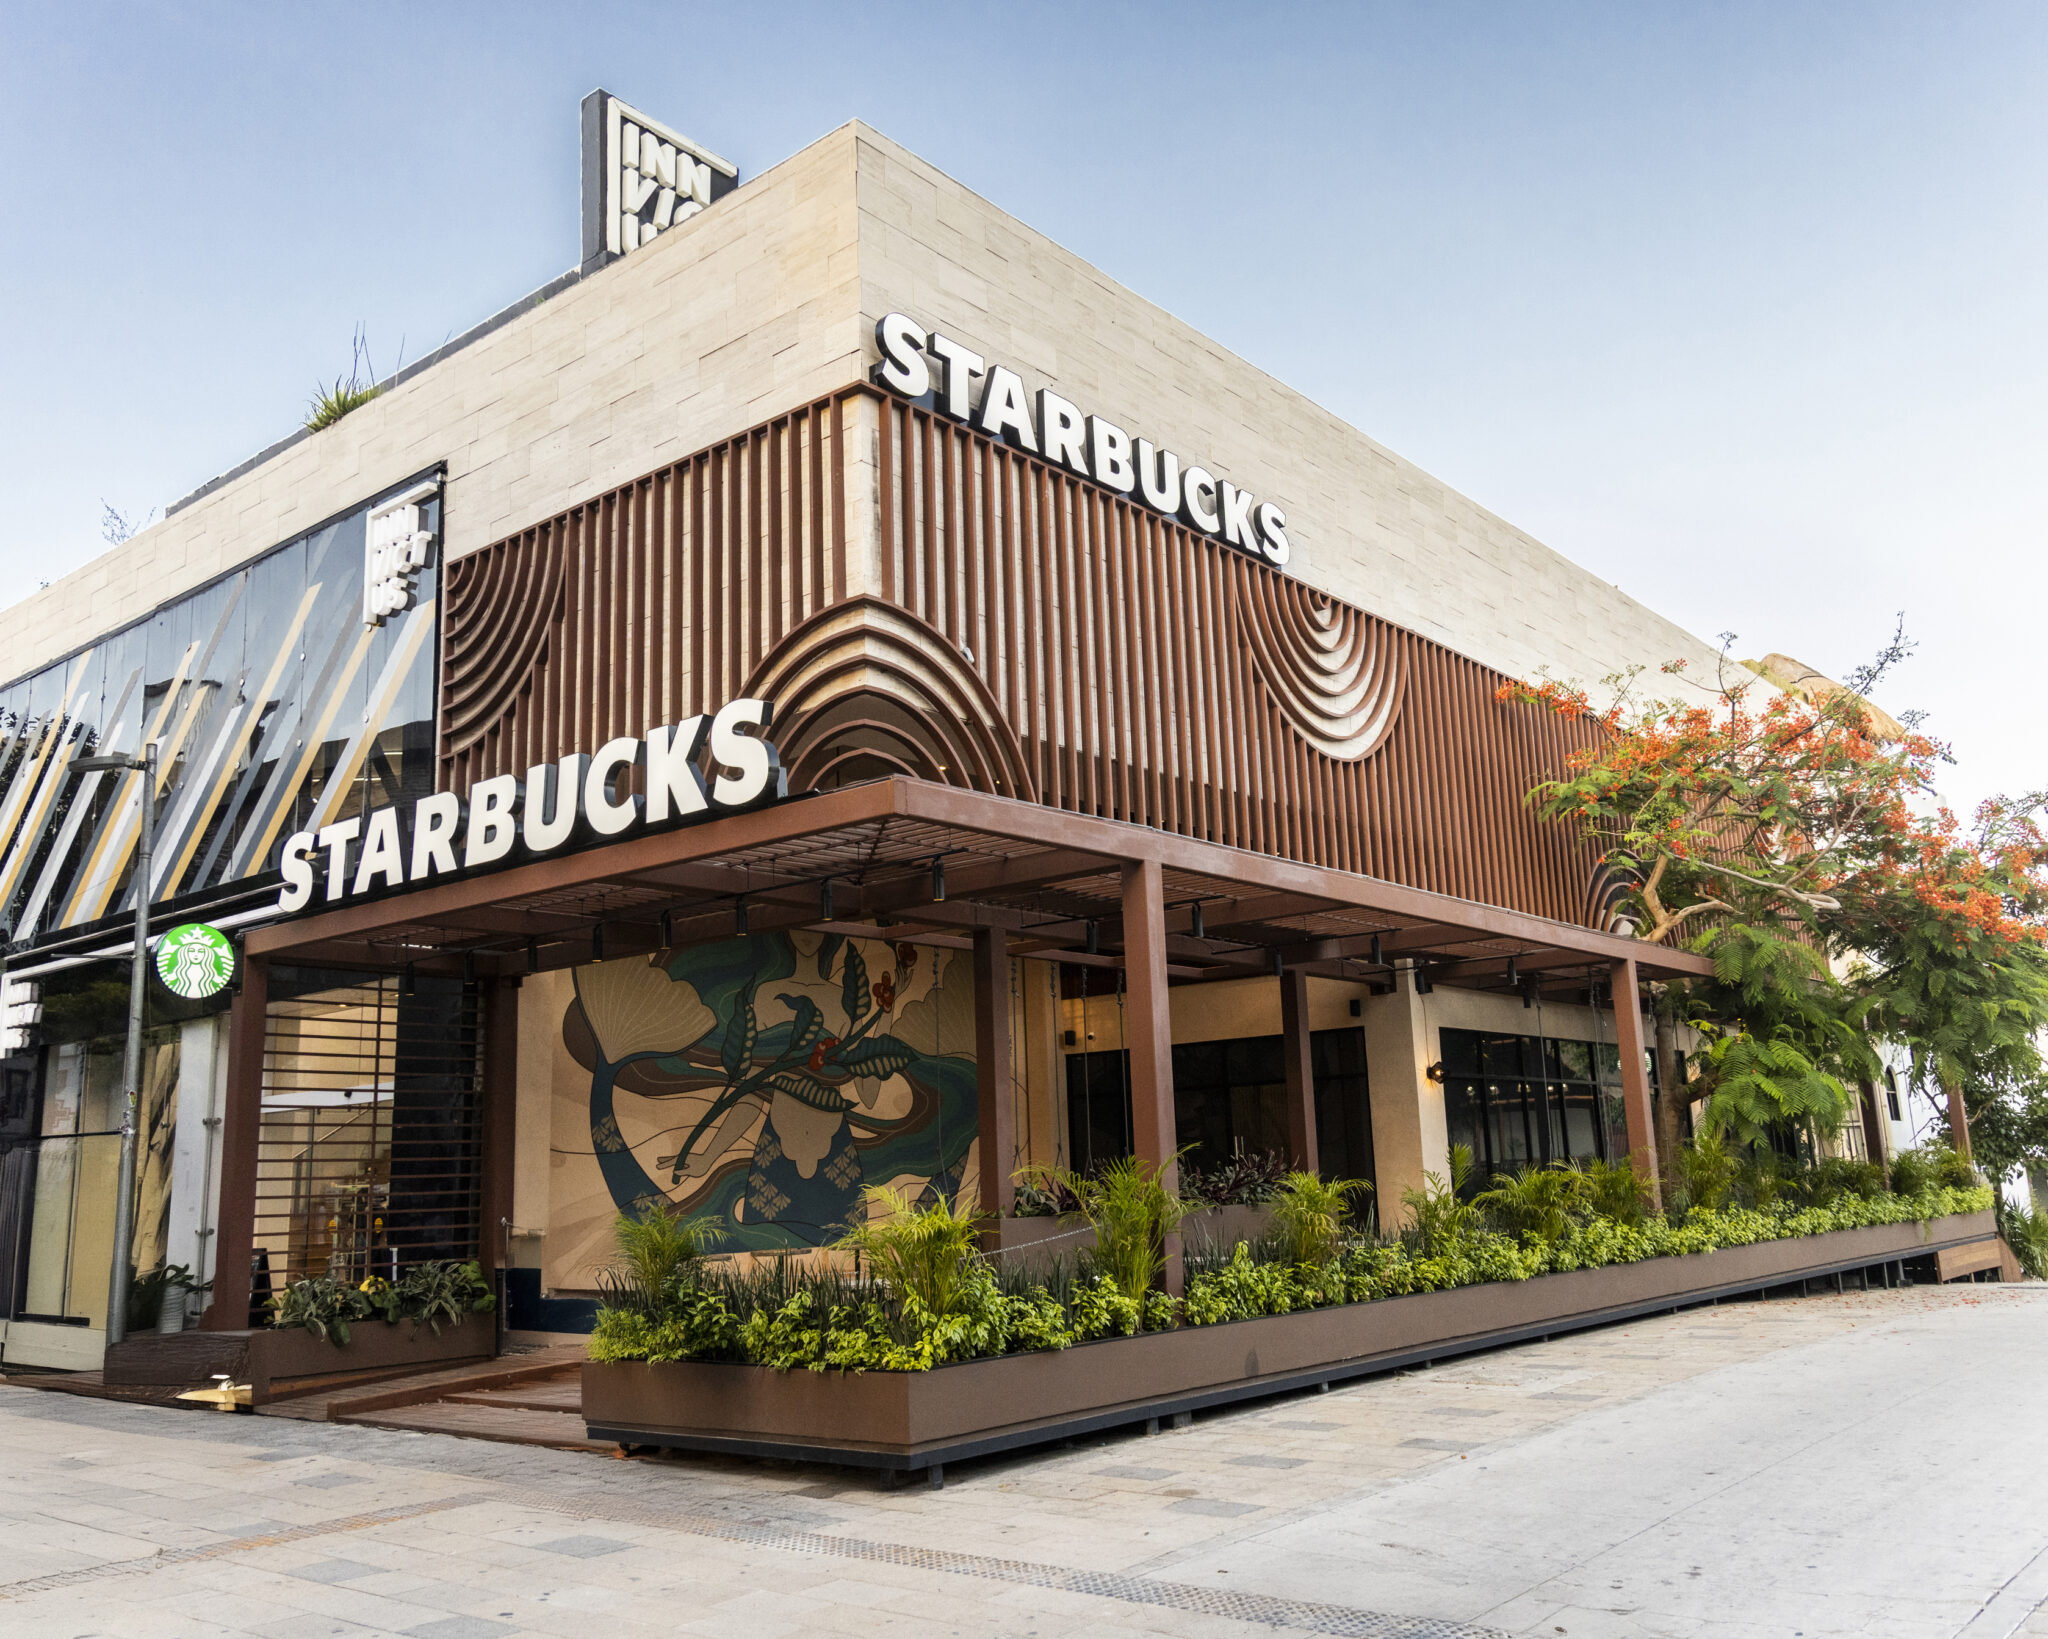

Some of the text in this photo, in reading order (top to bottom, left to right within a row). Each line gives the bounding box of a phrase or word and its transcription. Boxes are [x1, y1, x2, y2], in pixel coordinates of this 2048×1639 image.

[622, 122, 711, 208] INN
[875, 311, 1291, 567] STARBUCKS
[278, 698, 777, 913] STARBUCKS
